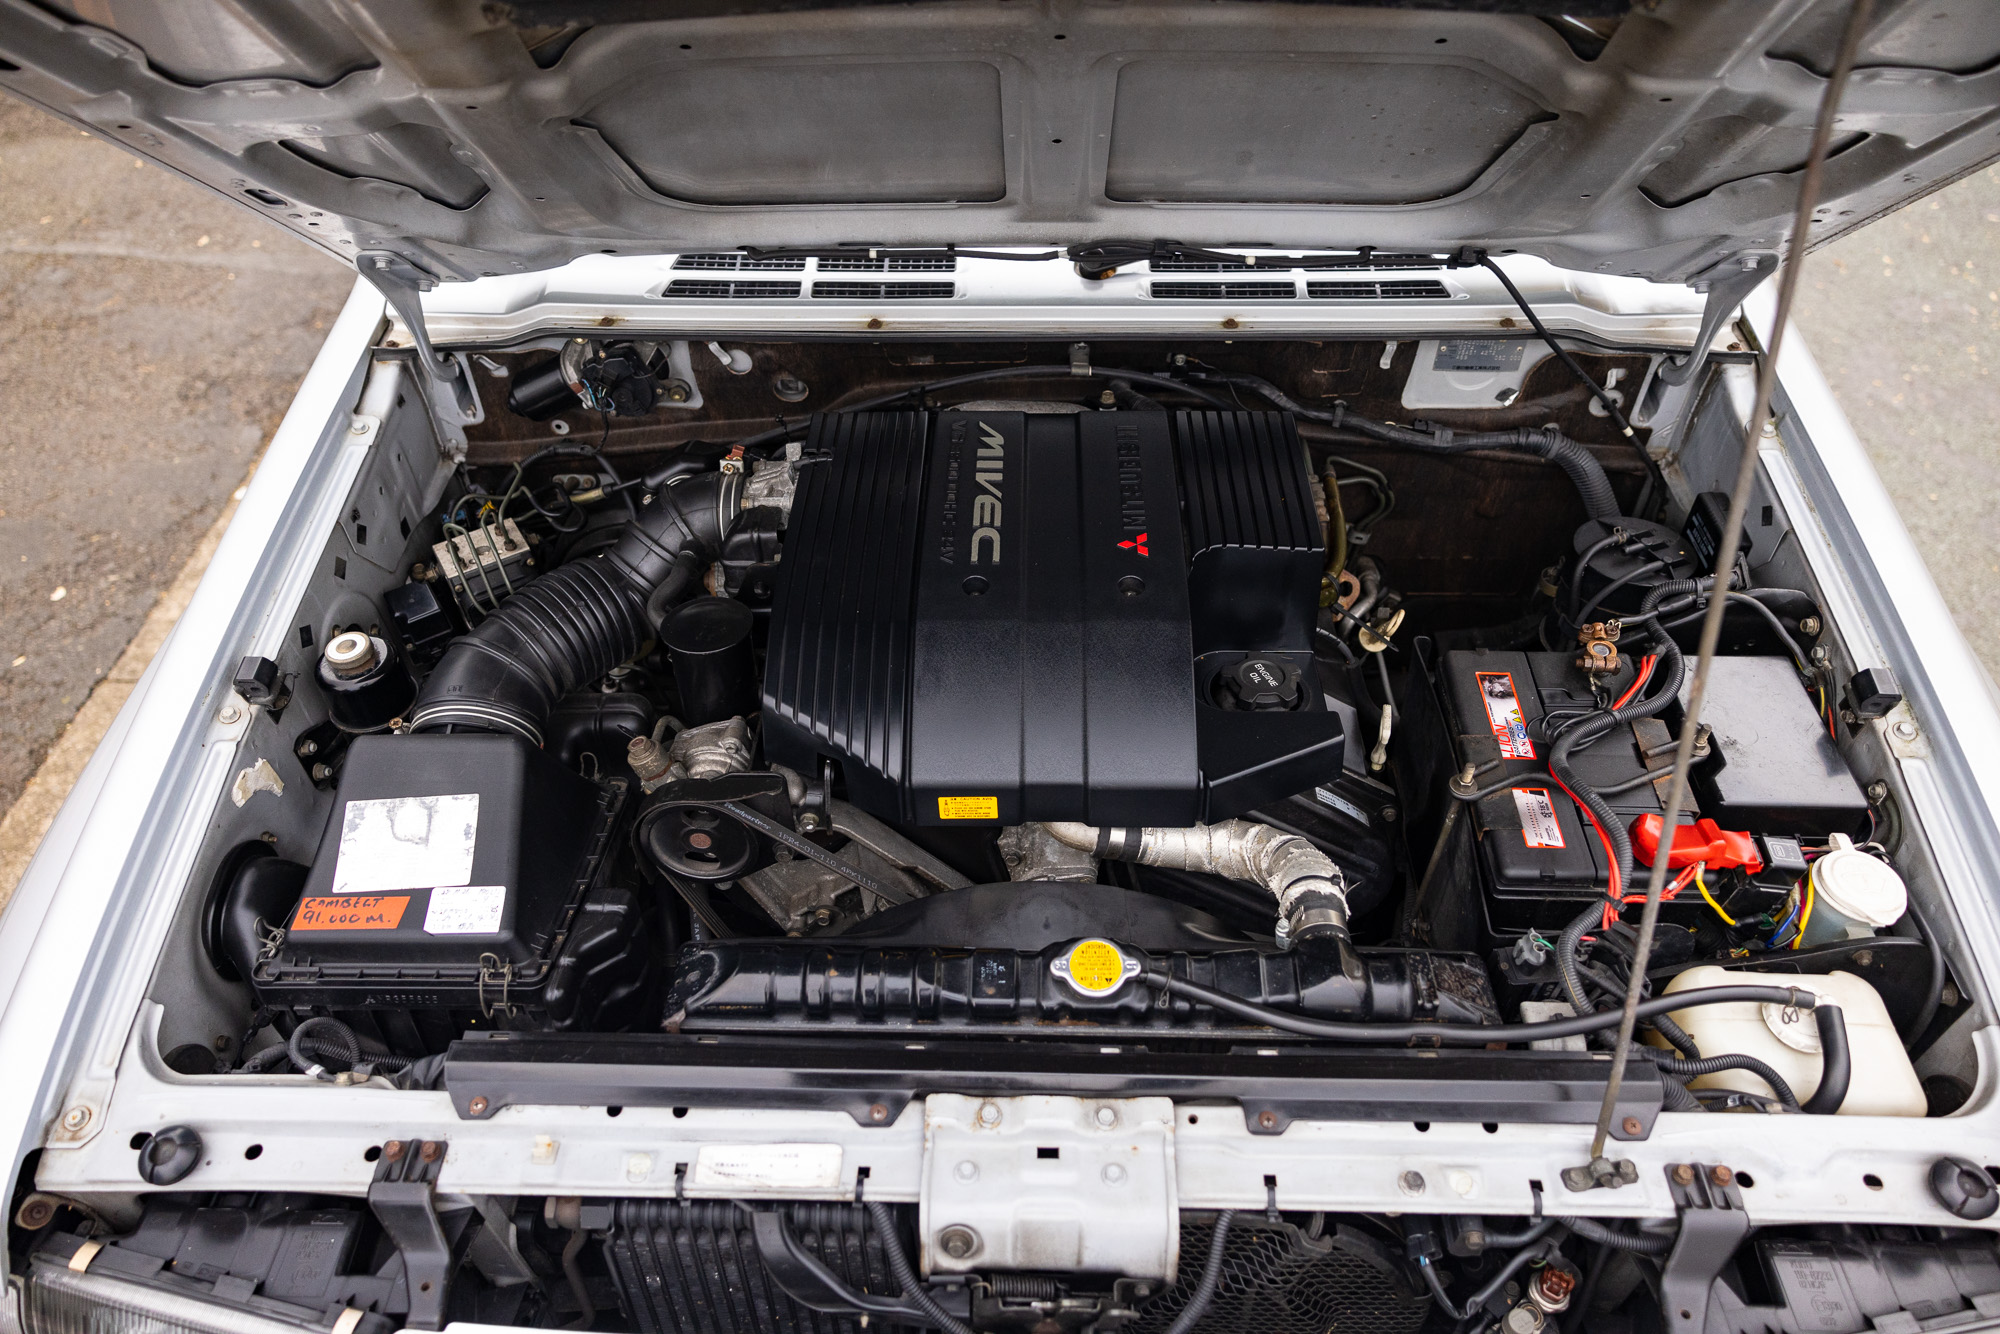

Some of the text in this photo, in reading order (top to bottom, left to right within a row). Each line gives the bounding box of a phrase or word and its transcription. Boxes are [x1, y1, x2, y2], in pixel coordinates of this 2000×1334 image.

[970, 421, 1004, 564] MIVEC
[1249, 672, 1262, 684] OIL
[1254, 663, 1279, 687] ENGINE
[1494, 723, 1515, 754] LION
[304, 897, 384, 909] CAMBELT
